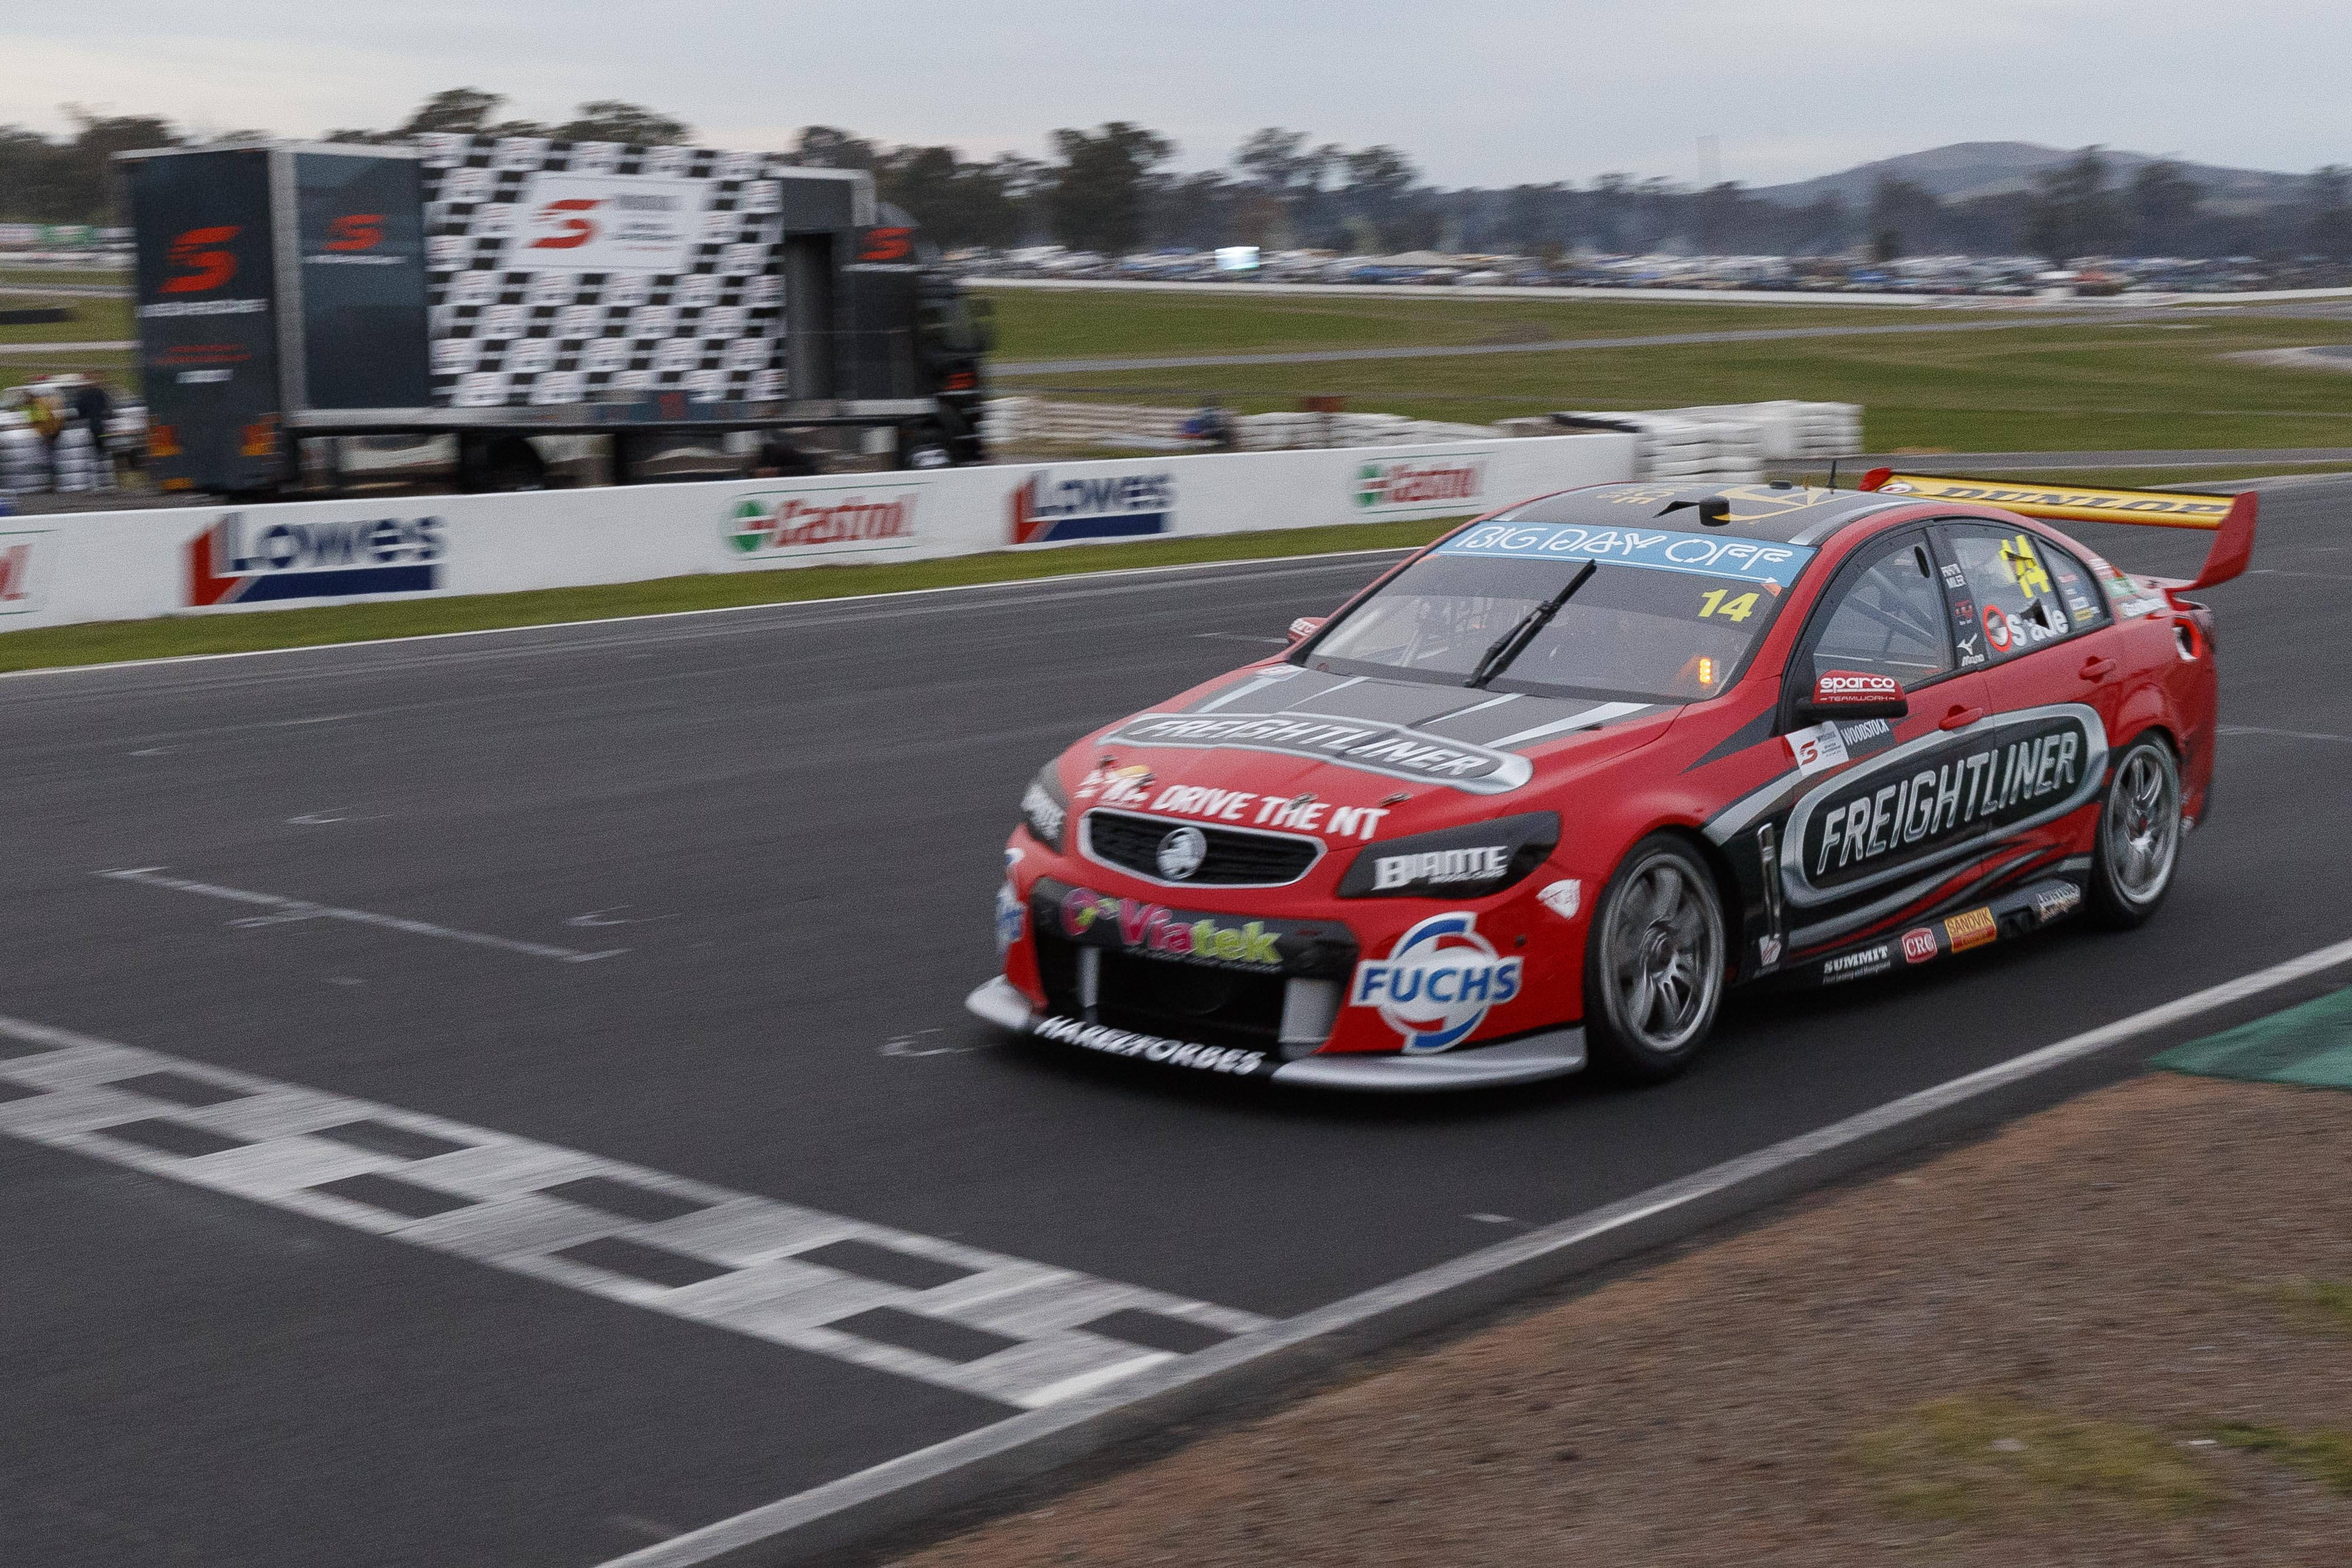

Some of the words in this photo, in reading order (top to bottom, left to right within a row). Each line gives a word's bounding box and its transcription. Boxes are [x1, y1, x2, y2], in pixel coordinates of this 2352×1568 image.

[1935, 487, 2231, 513] DUNLOP
[1455, 526, 1541, 550] BIG
[1538, 528, 1667, 556] DAY
[1665, 537, 1793, 570] OFF
[1697, 588, 1760, 622] 14
[1820, 677, 1896, 694] sparco
[1128, 719, 1489, 777] FREIGHTLINER
[1840, 718, 1889, 747] WOODSTOCK
[1149, 784, 1257, 821] DRIVE
[1253, 795, 1331, 831] THE
[1325, 806, 1391, 840] NT
[1816, 731, 2079, 876] FREIGHTLINER
[1371, 846, 1508, 891] BIANTE
[1947, 910, 1991, 934] SANDVIK
[1824, 945, 1888, 974] SUMMIT
[1906, 933, 1933, 957] CRC
[1358, 963, 1518, 1003] FUCHS
